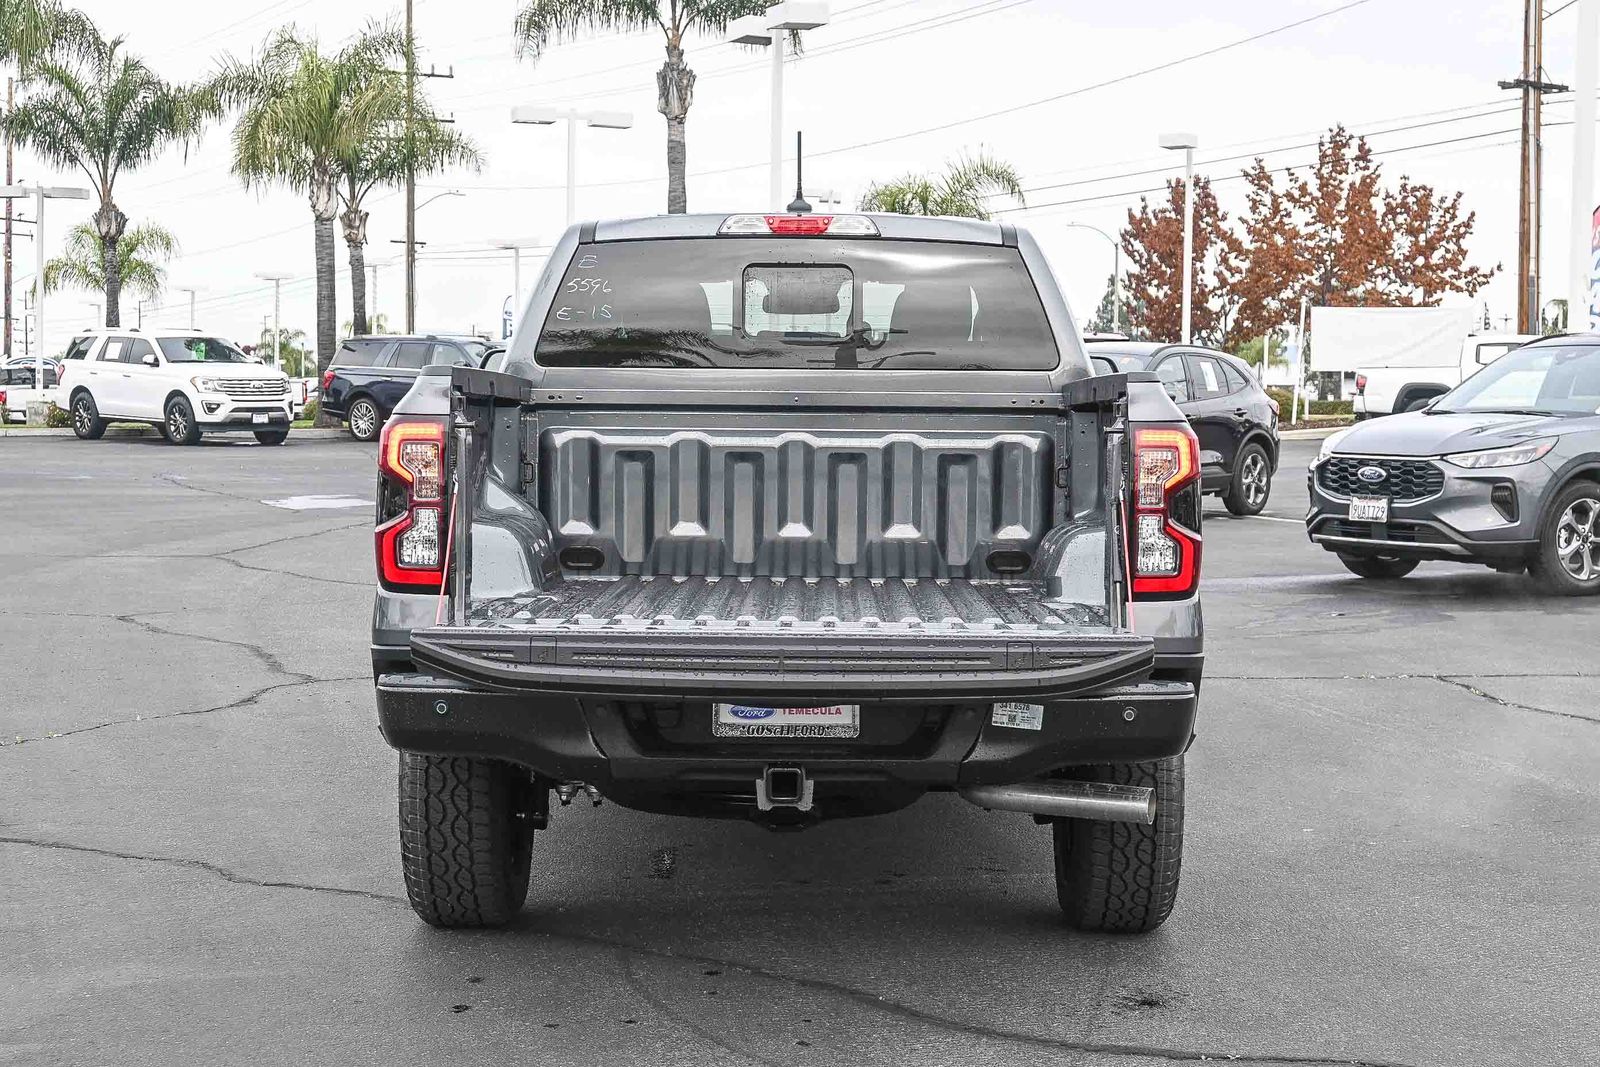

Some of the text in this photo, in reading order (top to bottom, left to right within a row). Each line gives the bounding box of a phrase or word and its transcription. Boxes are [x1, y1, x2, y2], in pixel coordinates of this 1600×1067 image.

[567, 278, 612, 296] 5596
[738, 706, 767, 718] Ford
[781, 706, 842, 716] TEMECULA
[793, 725, 825, 737] FORD
